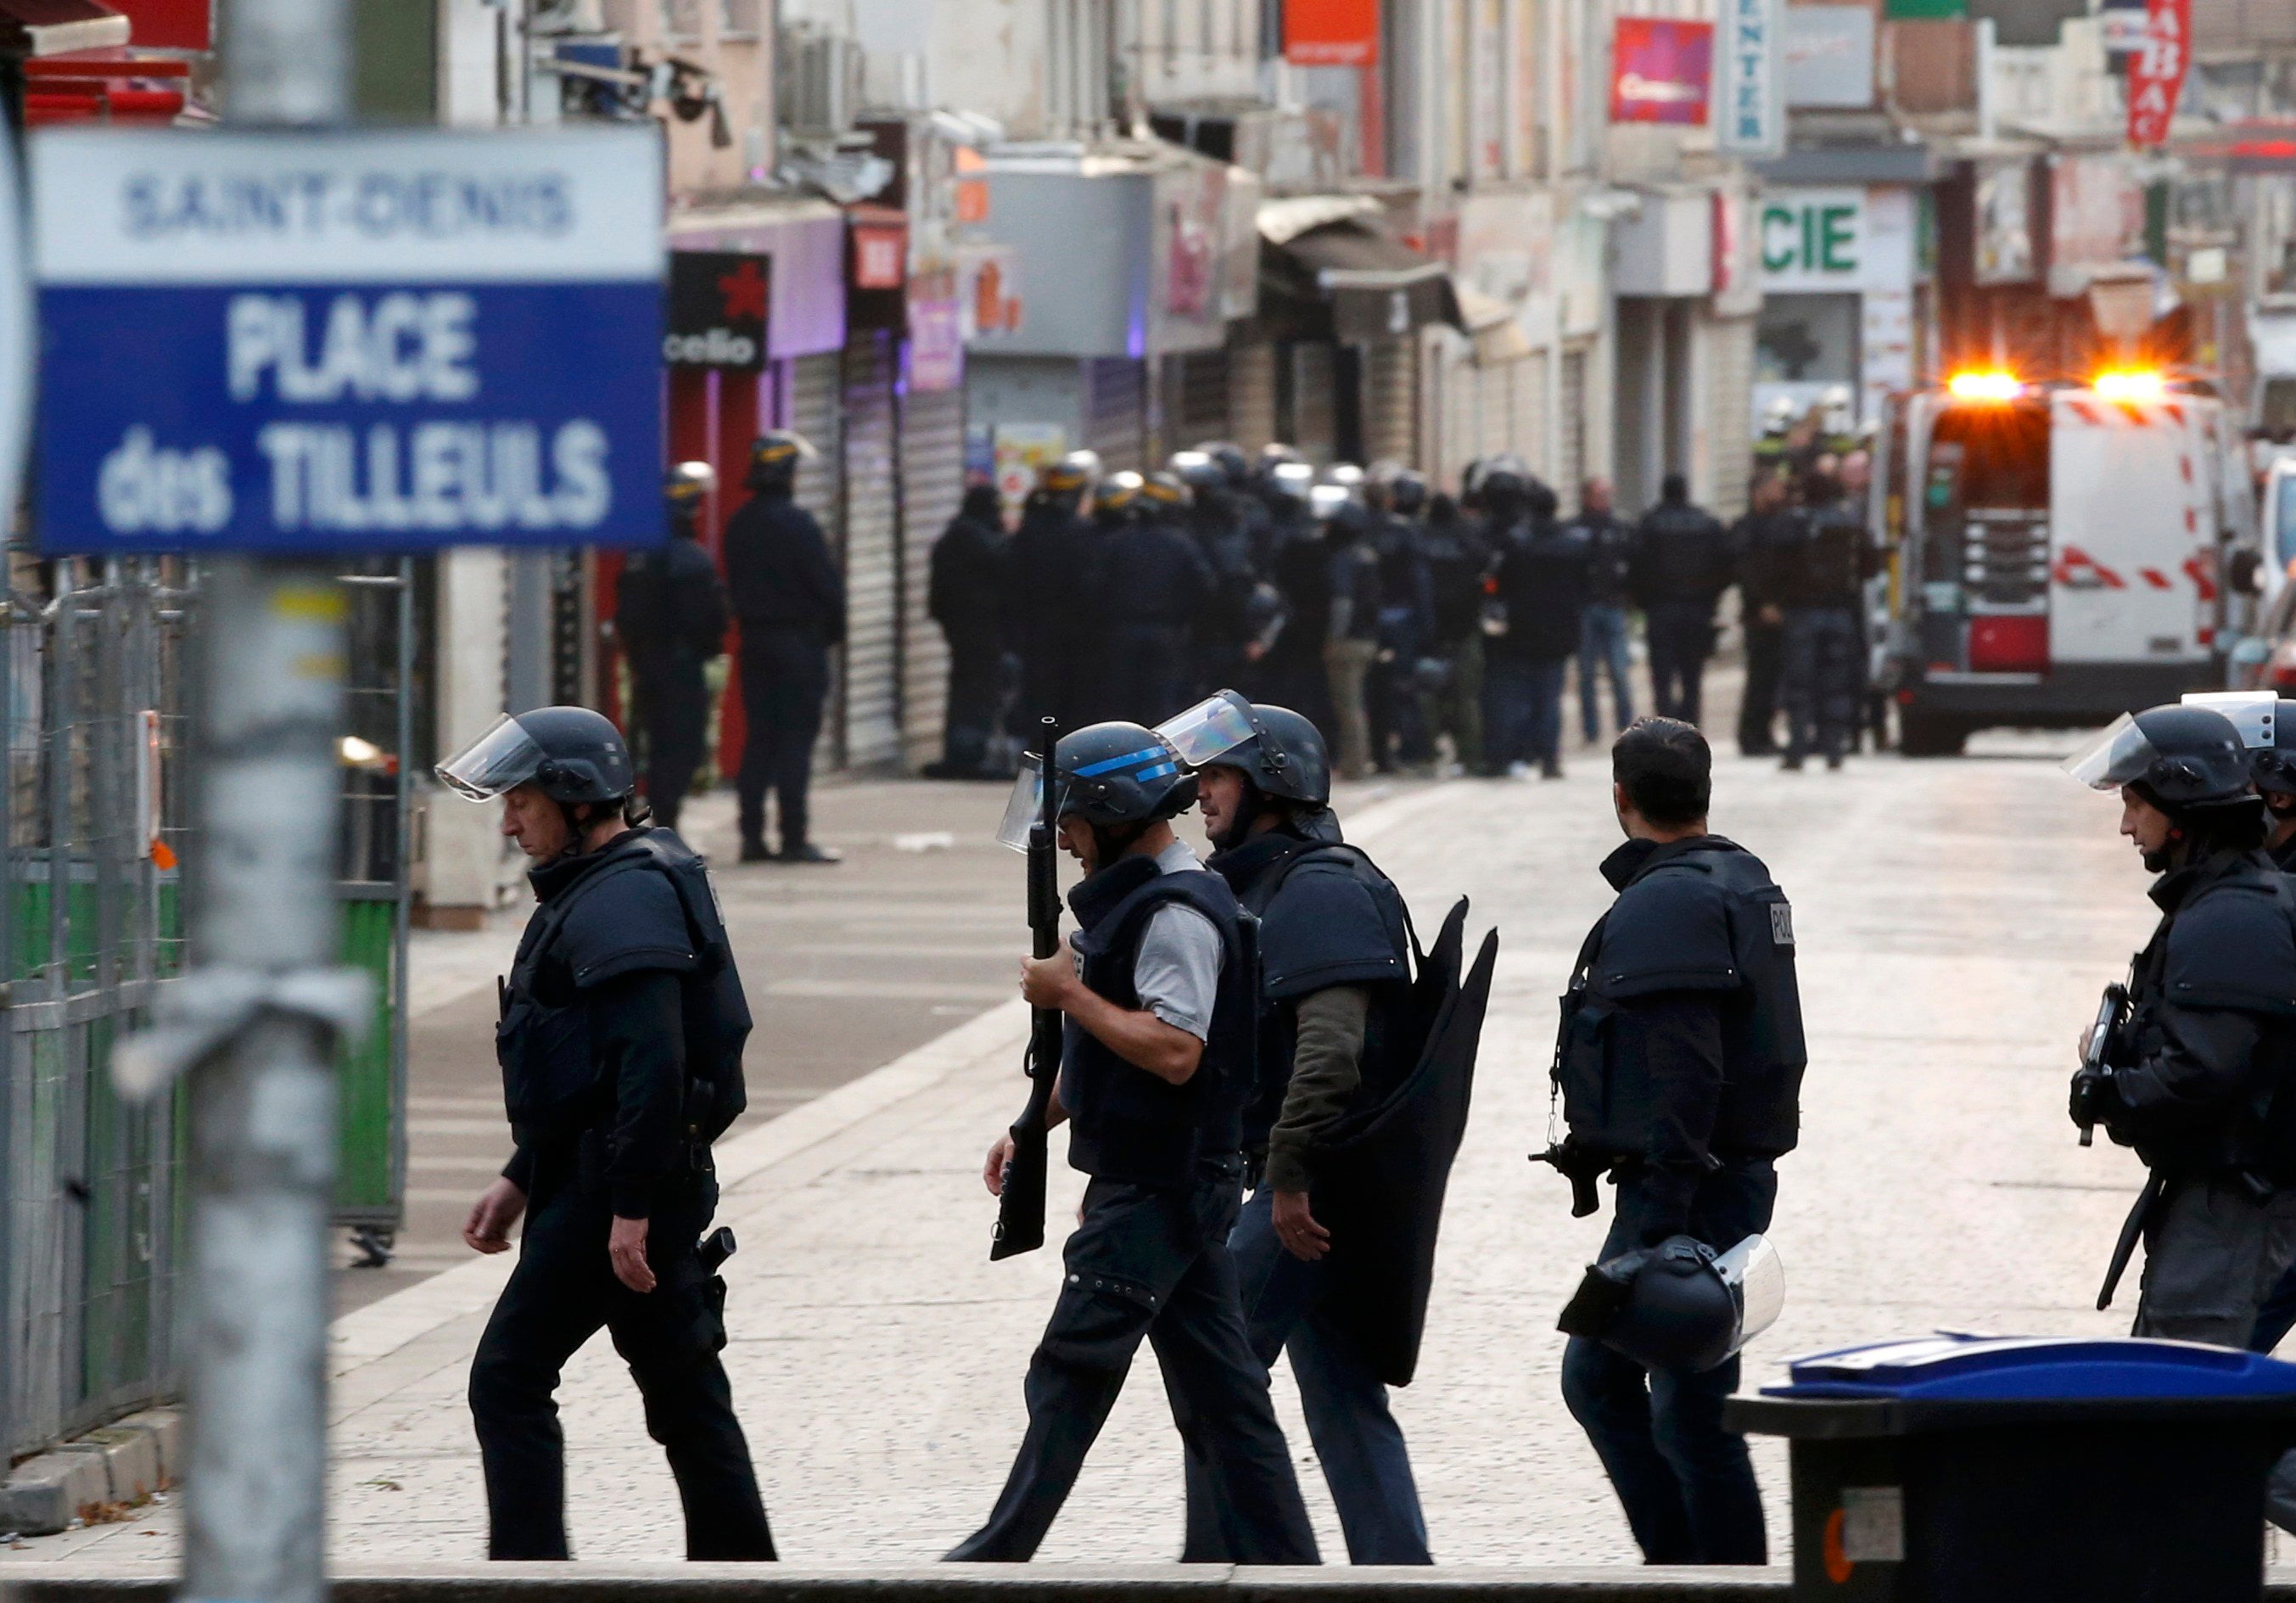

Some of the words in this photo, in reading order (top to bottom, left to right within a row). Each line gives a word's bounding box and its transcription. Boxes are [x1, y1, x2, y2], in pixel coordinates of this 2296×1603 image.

[2133, 2, 2180, 136] ABAC
[124, 171, 575, 238] SAINT-DENIS
[1761, 202, 1858, 272] CIE
[226, 292, 481, 402] PLACE
[662, 327, 757, 366] celio
[98, 423, 235, 535] des
[258, 419, 613, 533] TILLEULS
